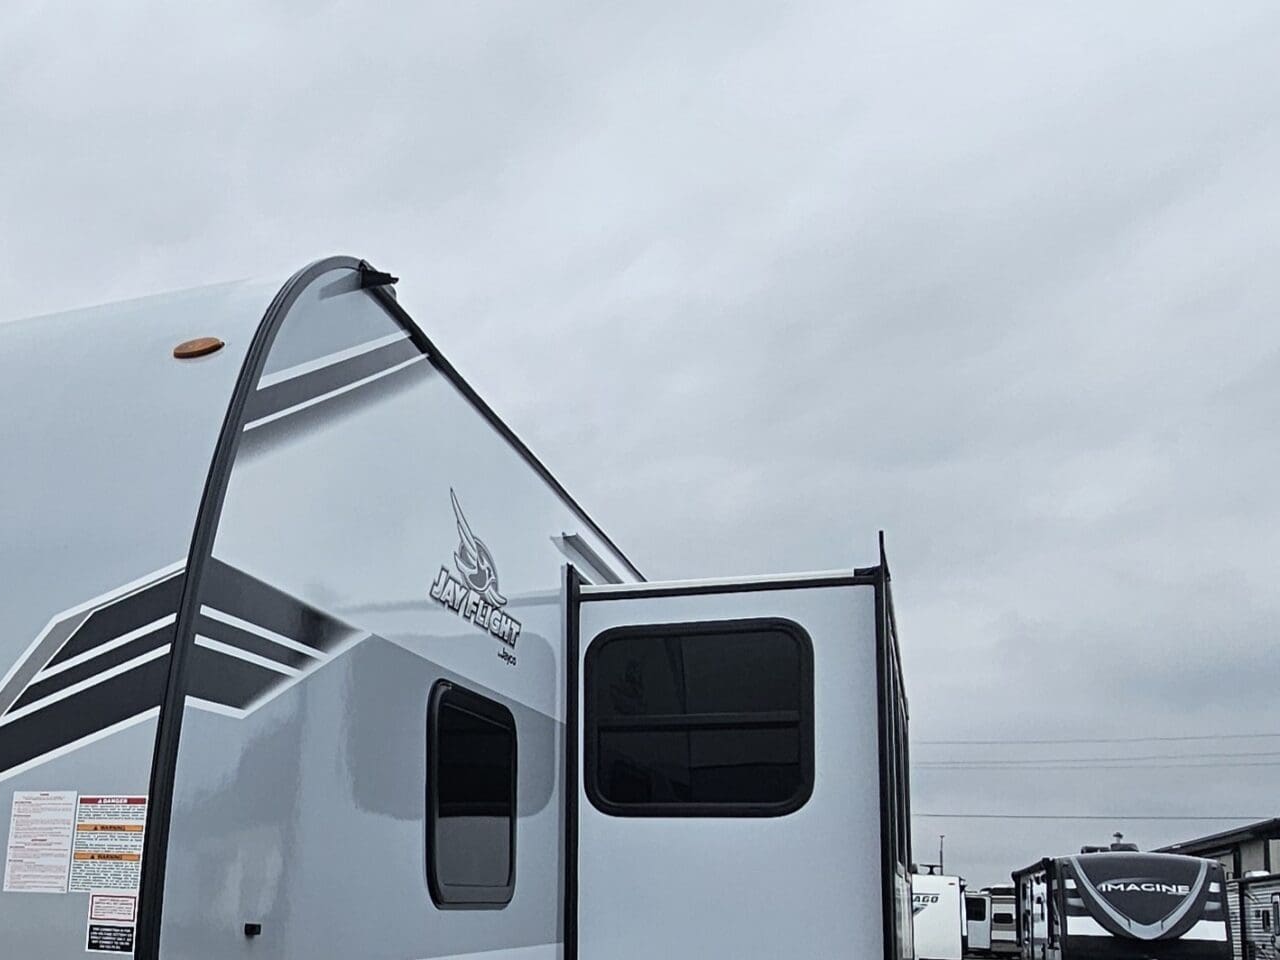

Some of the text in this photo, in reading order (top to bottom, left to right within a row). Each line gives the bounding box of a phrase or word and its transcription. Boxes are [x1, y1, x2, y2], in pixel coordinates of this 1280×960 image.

[497, 648, 517, 666] Jayco
[1101, 883, 1190, 895] IMAGINE
[913, 895, 939, 903] AGO
